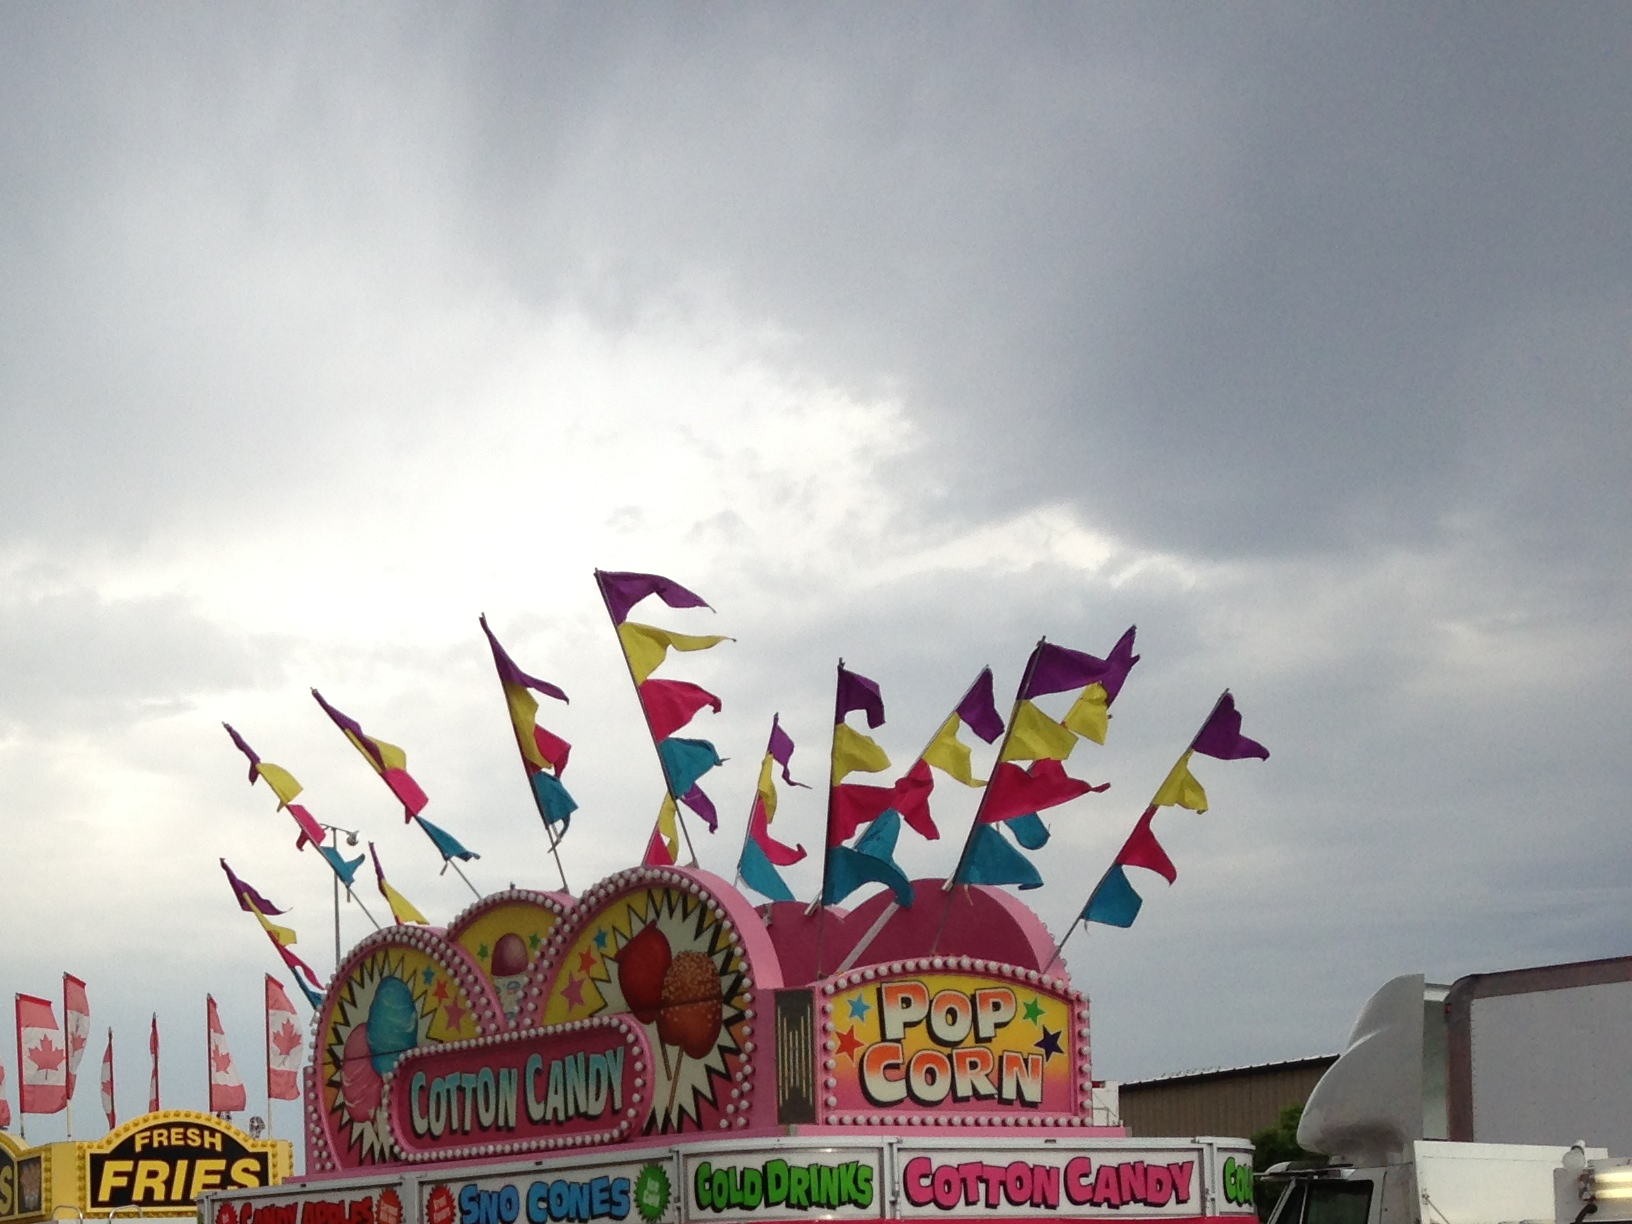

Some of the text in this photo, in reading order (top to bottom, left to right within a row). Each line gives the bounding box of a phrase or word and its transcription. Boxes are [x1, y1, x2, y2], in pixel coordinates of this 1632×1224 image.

[876, 980, 1017, 1047] POP
[411, 1046, 625, 1138] COTTON CANDY
[859, 1042, 1044, 1108] CORN
[134, 1128, 222, 1152] FRESH
[98, 1158, 261, 1202] FRIES
[695, 1161, 763, 1213] COLD
[764, 1158, 874, 1211] DRINKS
[903, 1156, 1195, 1210] COTTON CANDY
[1223, 1156, 1253, 1207] COL
